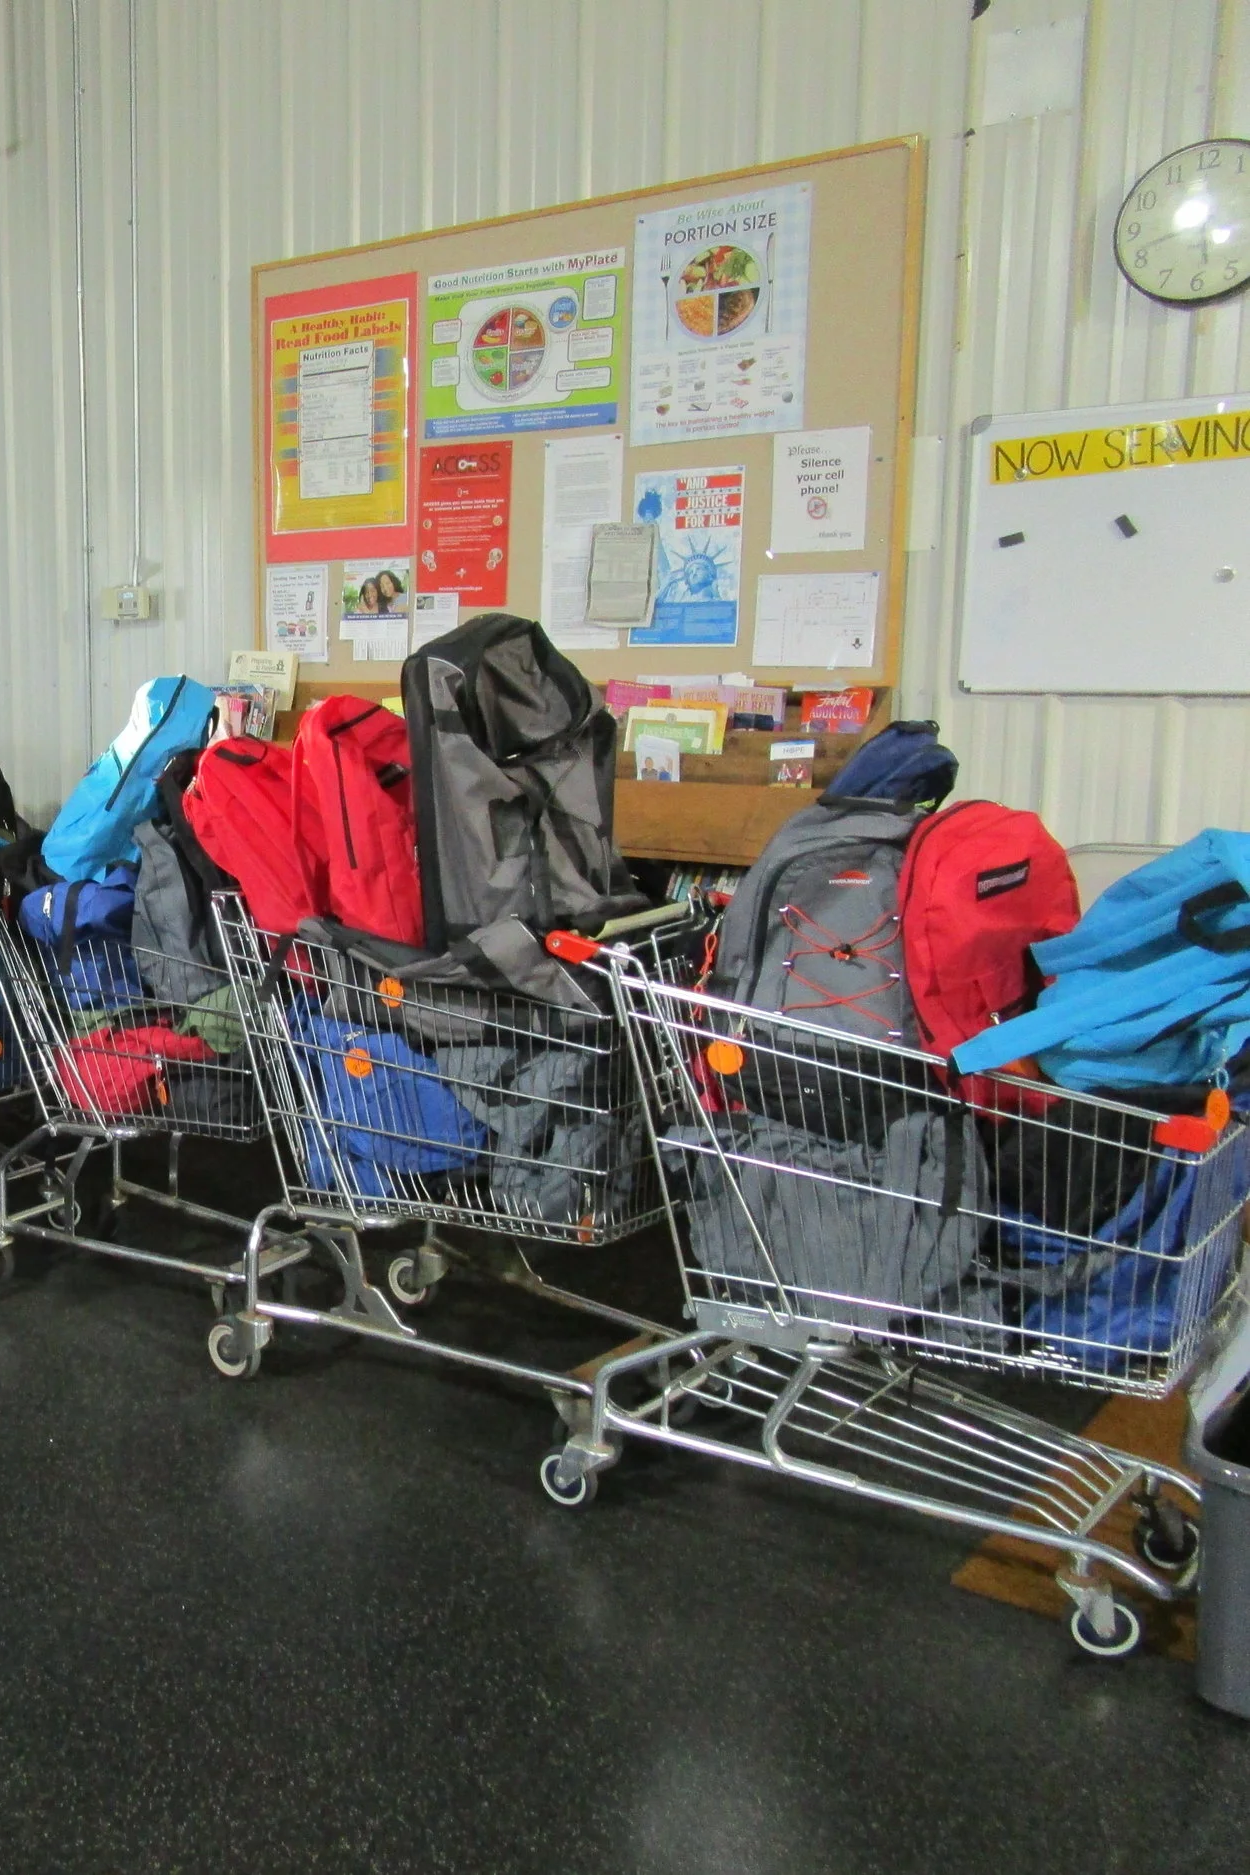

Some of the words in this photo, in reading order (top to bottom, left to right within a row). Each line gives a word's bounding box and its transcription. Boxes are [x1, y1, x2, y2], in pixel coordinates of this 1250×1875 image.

[1196, 149, 1222, 171] 12
[1235, 154, 1246, 174] 1
[1165, 164, 1183, 185] 11
[1134, 191, 1156, 212] 10
[677, 213, 692, 225] Be
[697, 208, 723, 221] Wise
[729, 200, 765, 215] About
[664, 221, 736, 246] PORTION
[743, 212, 777, 232] SIZE
[1127, 222, 1141, 242] 9
[1134, 249, 1148, 268] 8
[434, 275, 459, 289] Good
[461, 271, 504, 285] Nutrition
[507, 266, 539, 278] Starts
[543, 261, 565, 272] with
[568, 253, 618, 270] MyPlate
[1159, 268, 1173, 289] 7
[1223, 259, 1239, 281] 5
[1190, 271, 1206, 291] 6
[290, 325, 297, 334] A
[302, 318, 346, 332] Healthy
[350, 312, 386, 325] Habit:
[276, 334, 313, 350] Read
[315, 328, 349, 343] Food
[354, 320, 402, 338] Labels
[302, 349, 341, 362] Nutrition
[343, 345, 369, 357] Facts
[800, 458, 841, 468] Silence
[994, 433, 1088, 481] NOW
[797, 473, 822, 484] your
[825, 470, 844, 480] cell
[800, 484, 839, 496] phone!
[685, 494, 728, 510] JUSTICE
[685, 516, 705, 528] FOR
[809, 707, 860, 720] ADDICTION
